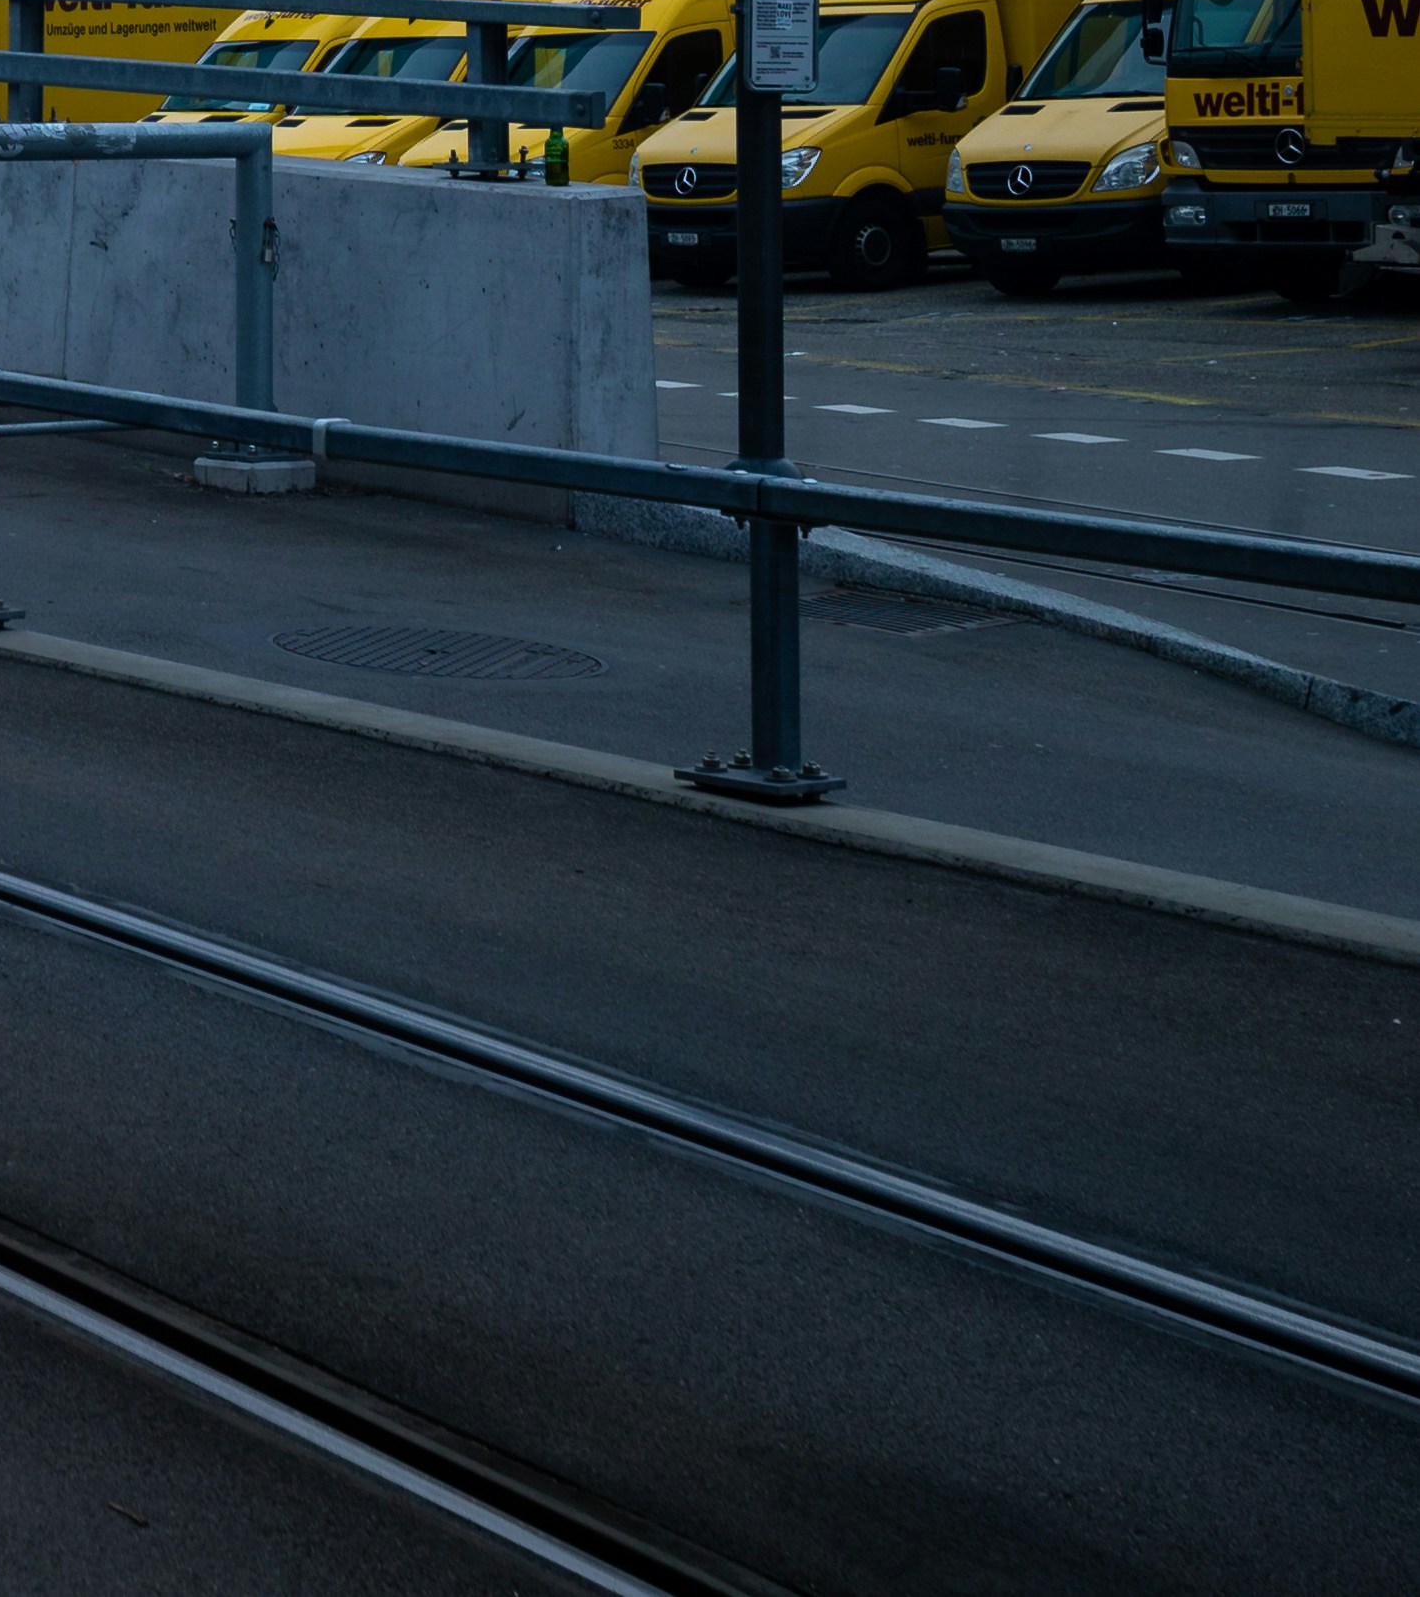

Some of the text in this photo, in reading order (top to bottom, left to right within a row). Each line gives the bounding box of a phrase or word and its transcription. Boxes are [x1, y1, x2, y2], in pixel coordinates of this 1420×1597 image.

[46, 18, 217, 39] Umzüge und Lagerungen weltweit
[1193, 82, 1304, 118] welti-f
